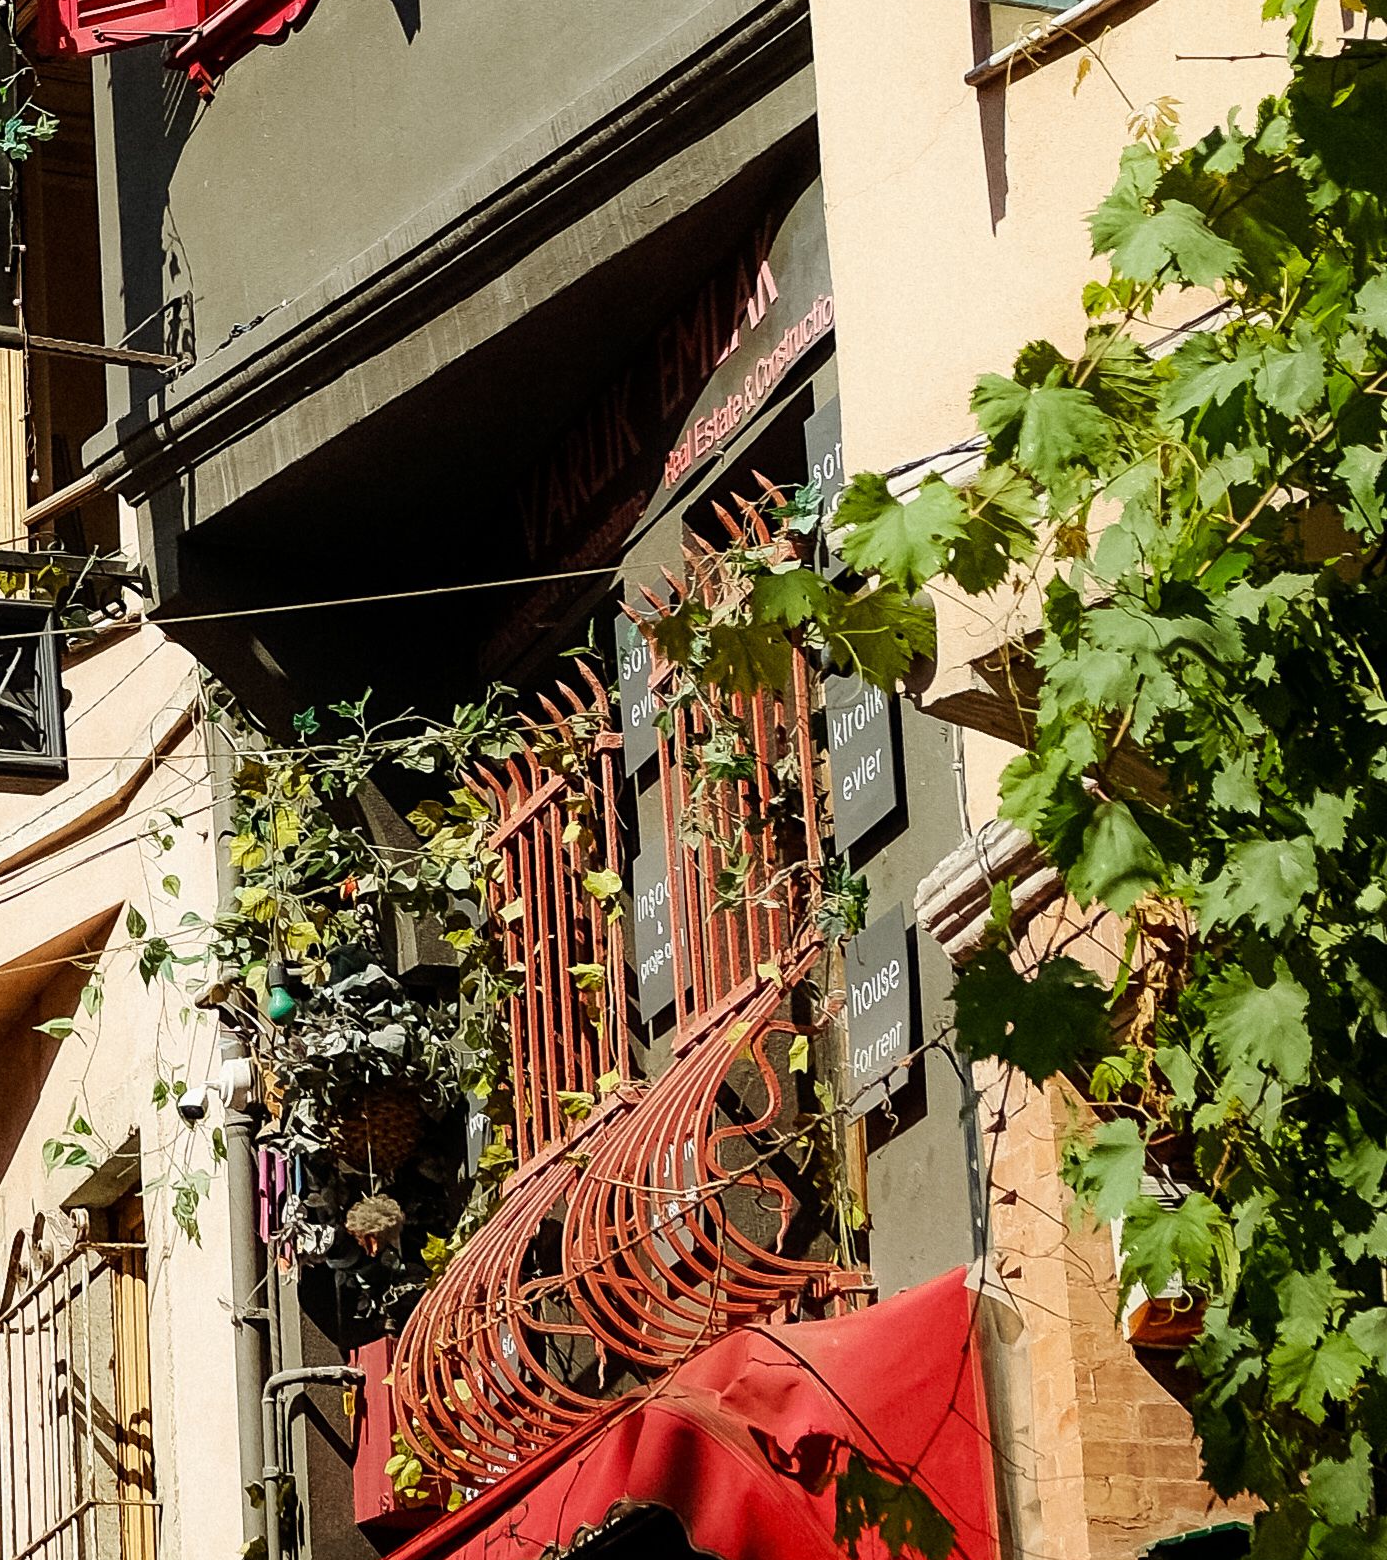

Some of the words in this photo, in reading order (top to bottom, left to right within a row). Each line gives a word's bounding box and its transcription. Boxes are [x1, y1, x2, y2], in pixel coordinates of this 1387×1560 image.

[664, 429, 692, 491] Real
[693, 393, 744, 460] Estate
[743, 374, 758, 414] &
[754, 293, 835, 400] Constructio
[842, 748, 882, 801] evler
[851, 959, 900, 1019] house
[853, 1044, 875, 1079] for
[875, 1020, 903, 1062] rent
